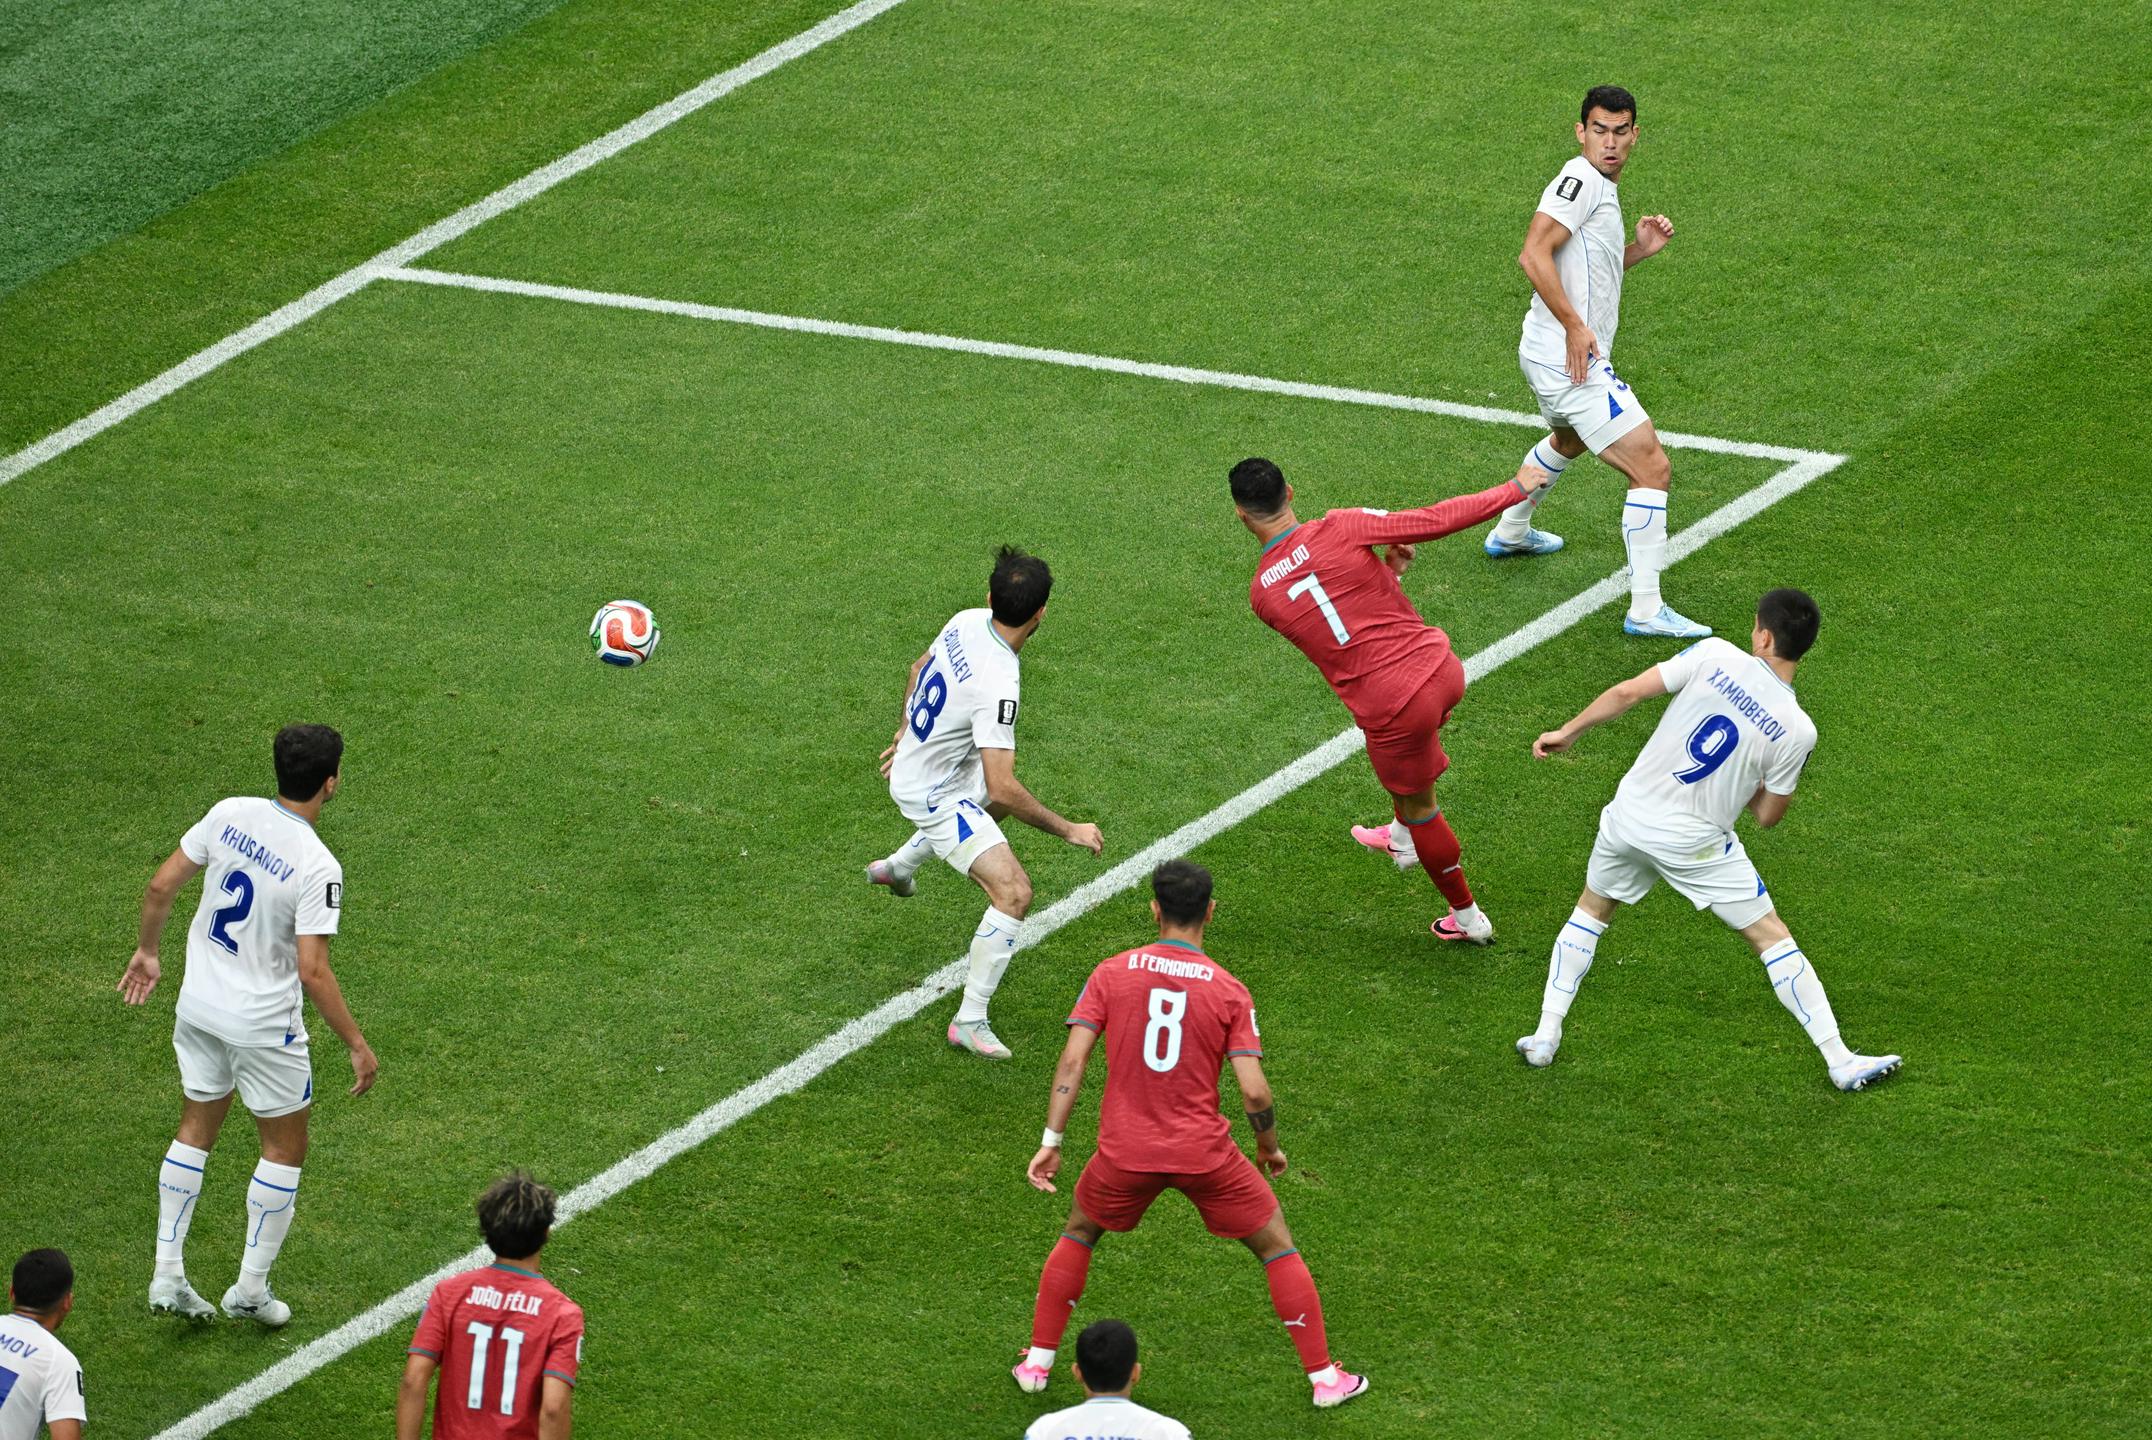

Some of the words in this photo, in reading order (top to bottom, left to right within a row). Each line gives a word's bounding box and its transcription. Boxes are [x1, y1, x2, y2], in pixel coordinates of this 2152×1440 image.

[1260, 543, 1310, 589] RONALDO
[1287, 571, 1351, 646] 7
[908, 653, 948, 743] 18
[1706, 667, 1786, 743] XAMROBEKOV
[1672, 713, 1740, 786] 9
[220, 824, 294, 882] KHUSANOV
[208, 870, 254, 957] 2
[1143, 987, 1187, 1073] 8
[465, 1285, 503, 1310] JOÃO
[502, 1290, 543, 1316] FÉLIX
[466, 1321, 526, 1417] 11
